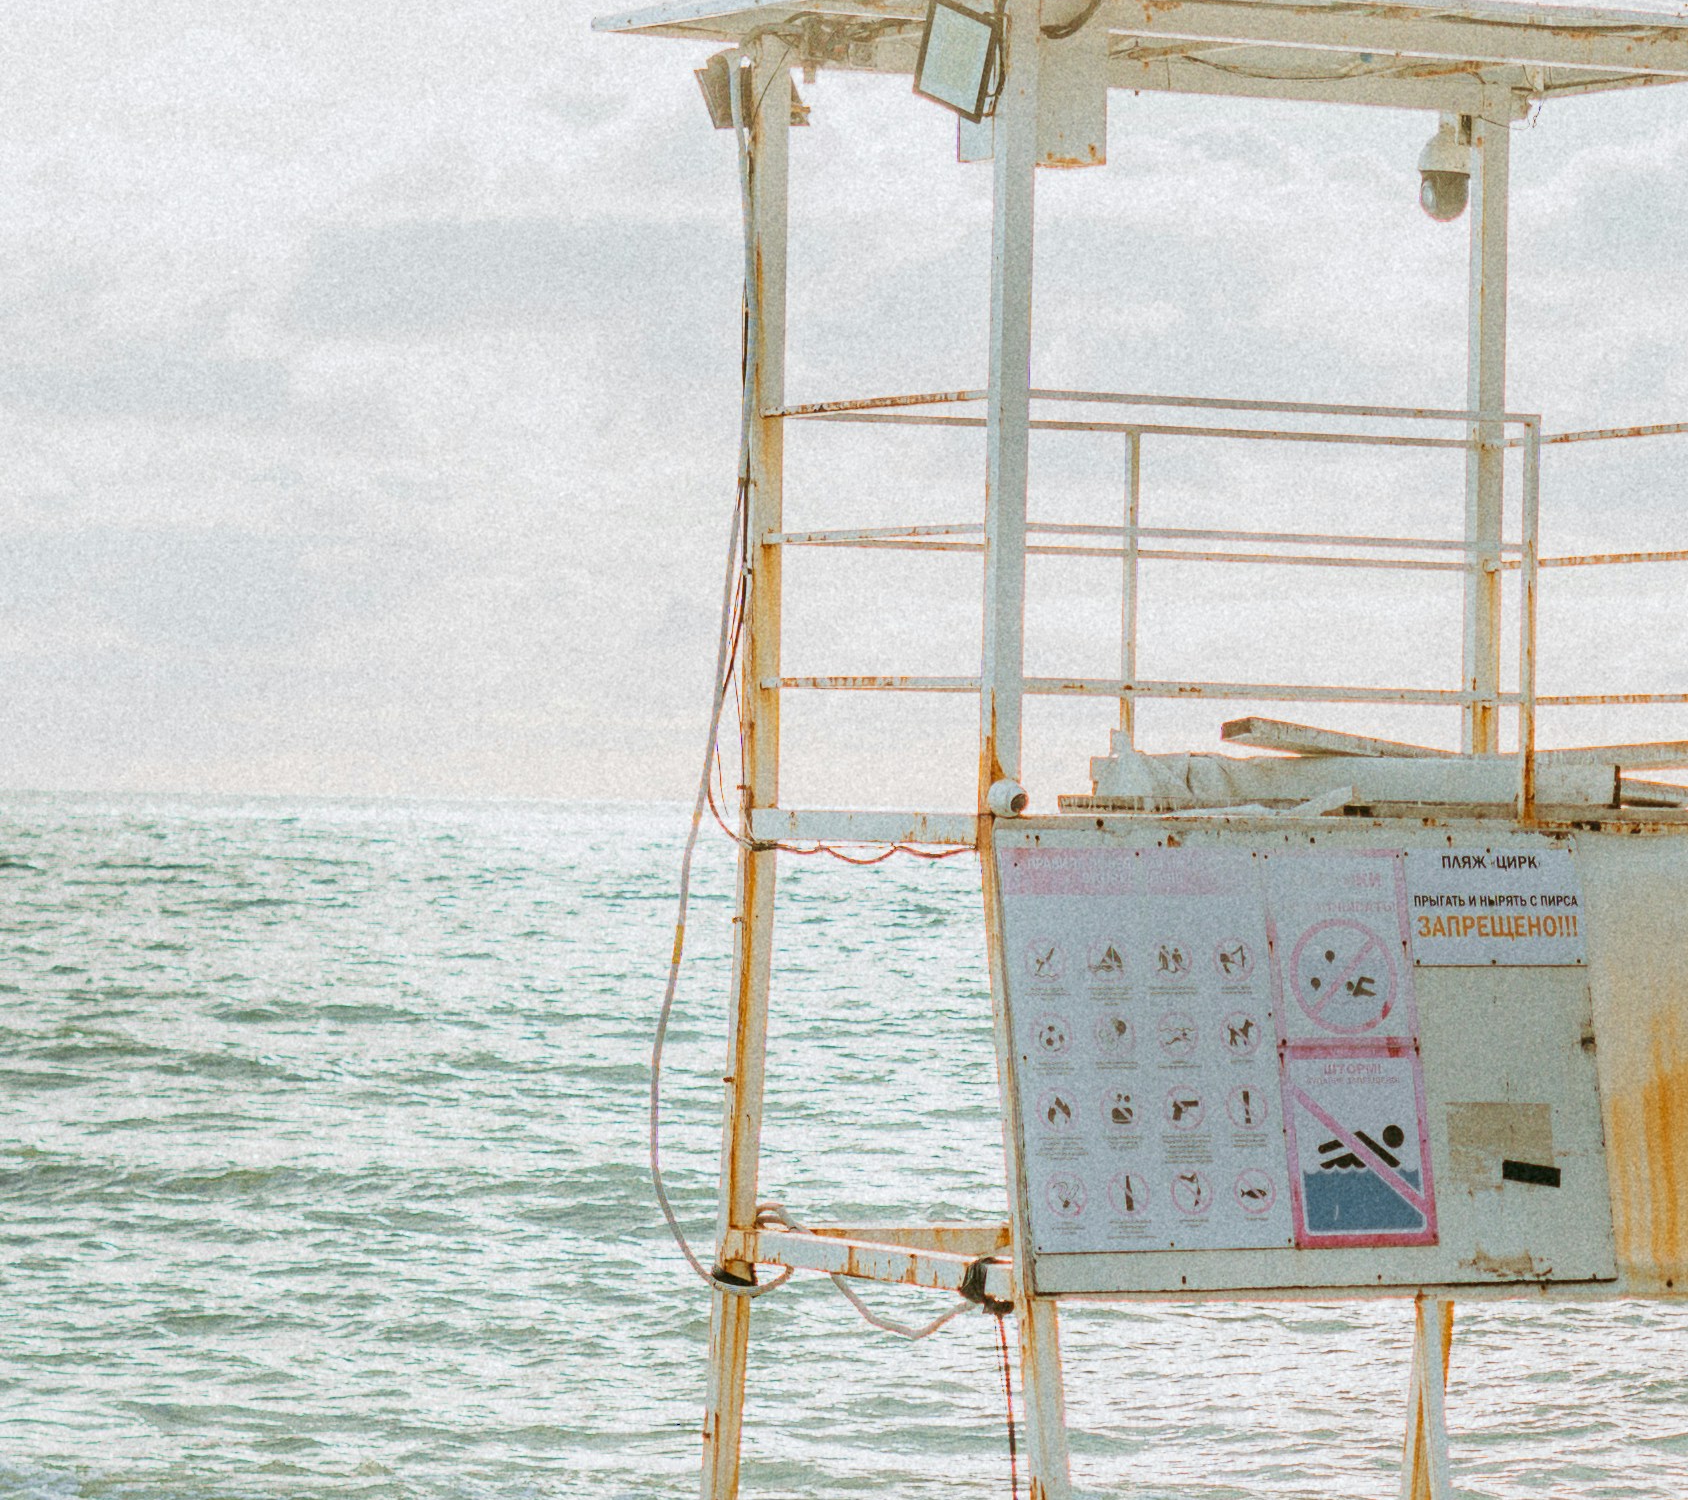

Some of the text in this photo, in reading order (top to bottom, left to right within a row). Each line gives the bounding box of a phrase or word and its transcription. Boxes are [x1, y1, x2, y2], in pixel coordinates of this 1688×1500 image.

[1442, 855, 1486, 869] ПЛЯЖ
[1414, 895, 1578, 907] ПРЫГАТЬ И НЫРЯТЬ С ПИРСА
[1417, 915, 1578, 941] ЗАПРЕЩЕНО!!!
[1324, 1063, 1382, 1075] ШТОРМ!
